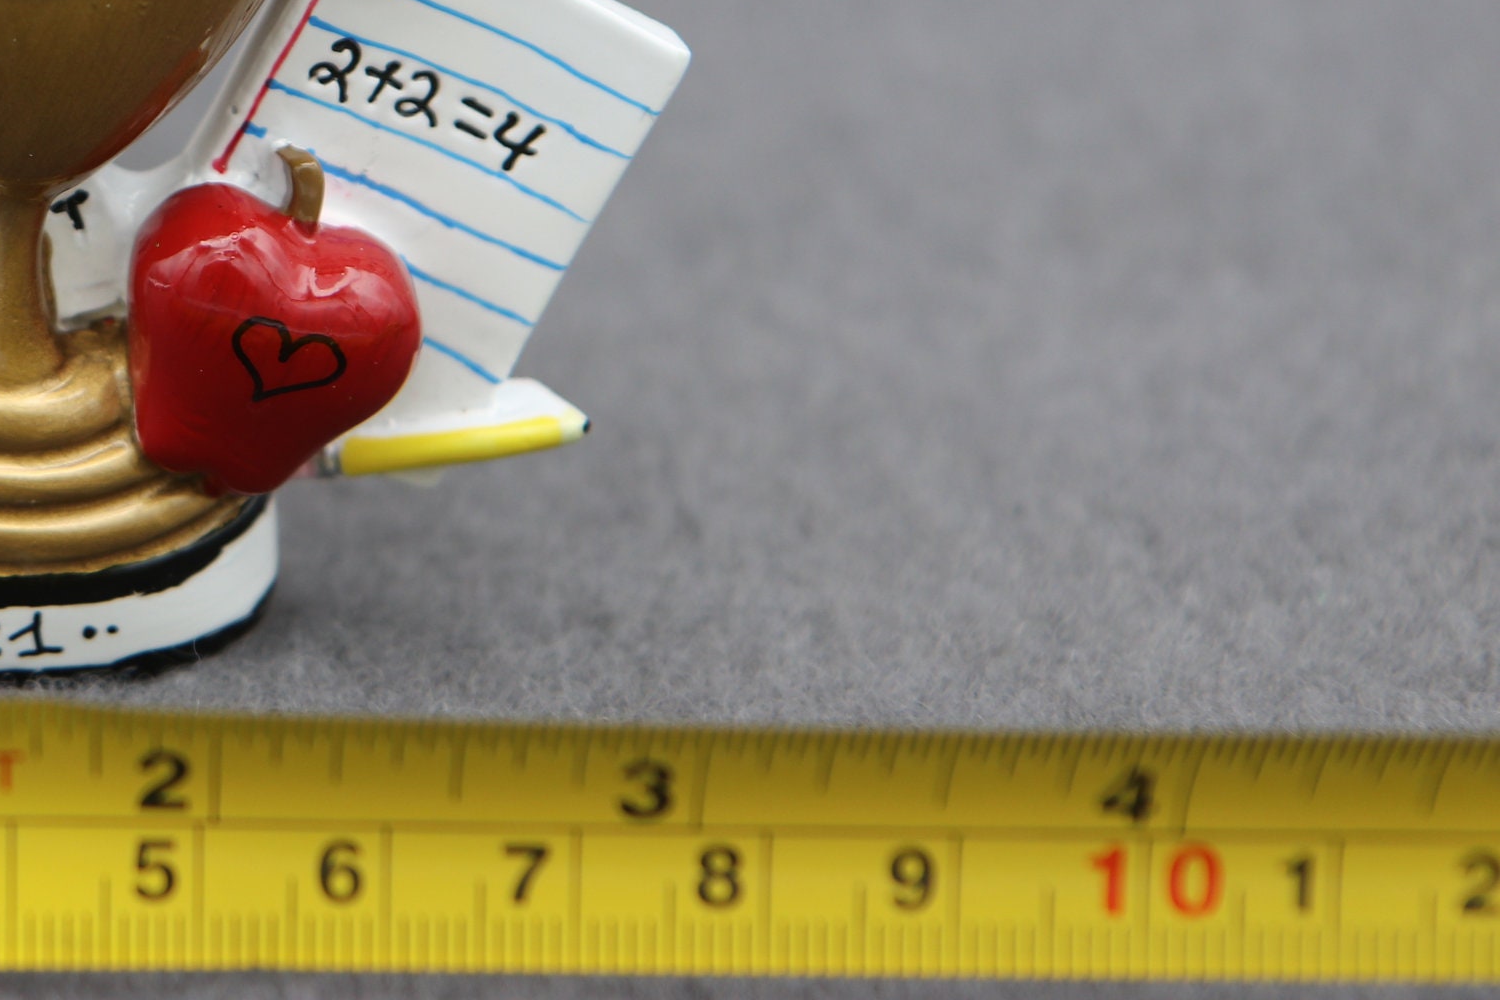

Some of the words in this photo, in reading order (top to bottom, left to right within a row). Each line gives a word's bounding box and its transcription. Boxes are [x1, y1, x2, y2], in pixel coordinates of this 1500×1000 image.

[137, 749, 192, 812] 2
[618, 759, 675, 820] 3
[1100, 764, 1158, 823] 4
[134, 838, 177, 902] 5
[318, 839, 366, 904] 6
[502, 844, 550, 904] 7
[694, 845, 744, 909] 8
[888, 846, 937, 913] 9
[1288, 854, 1314, 914] 1
